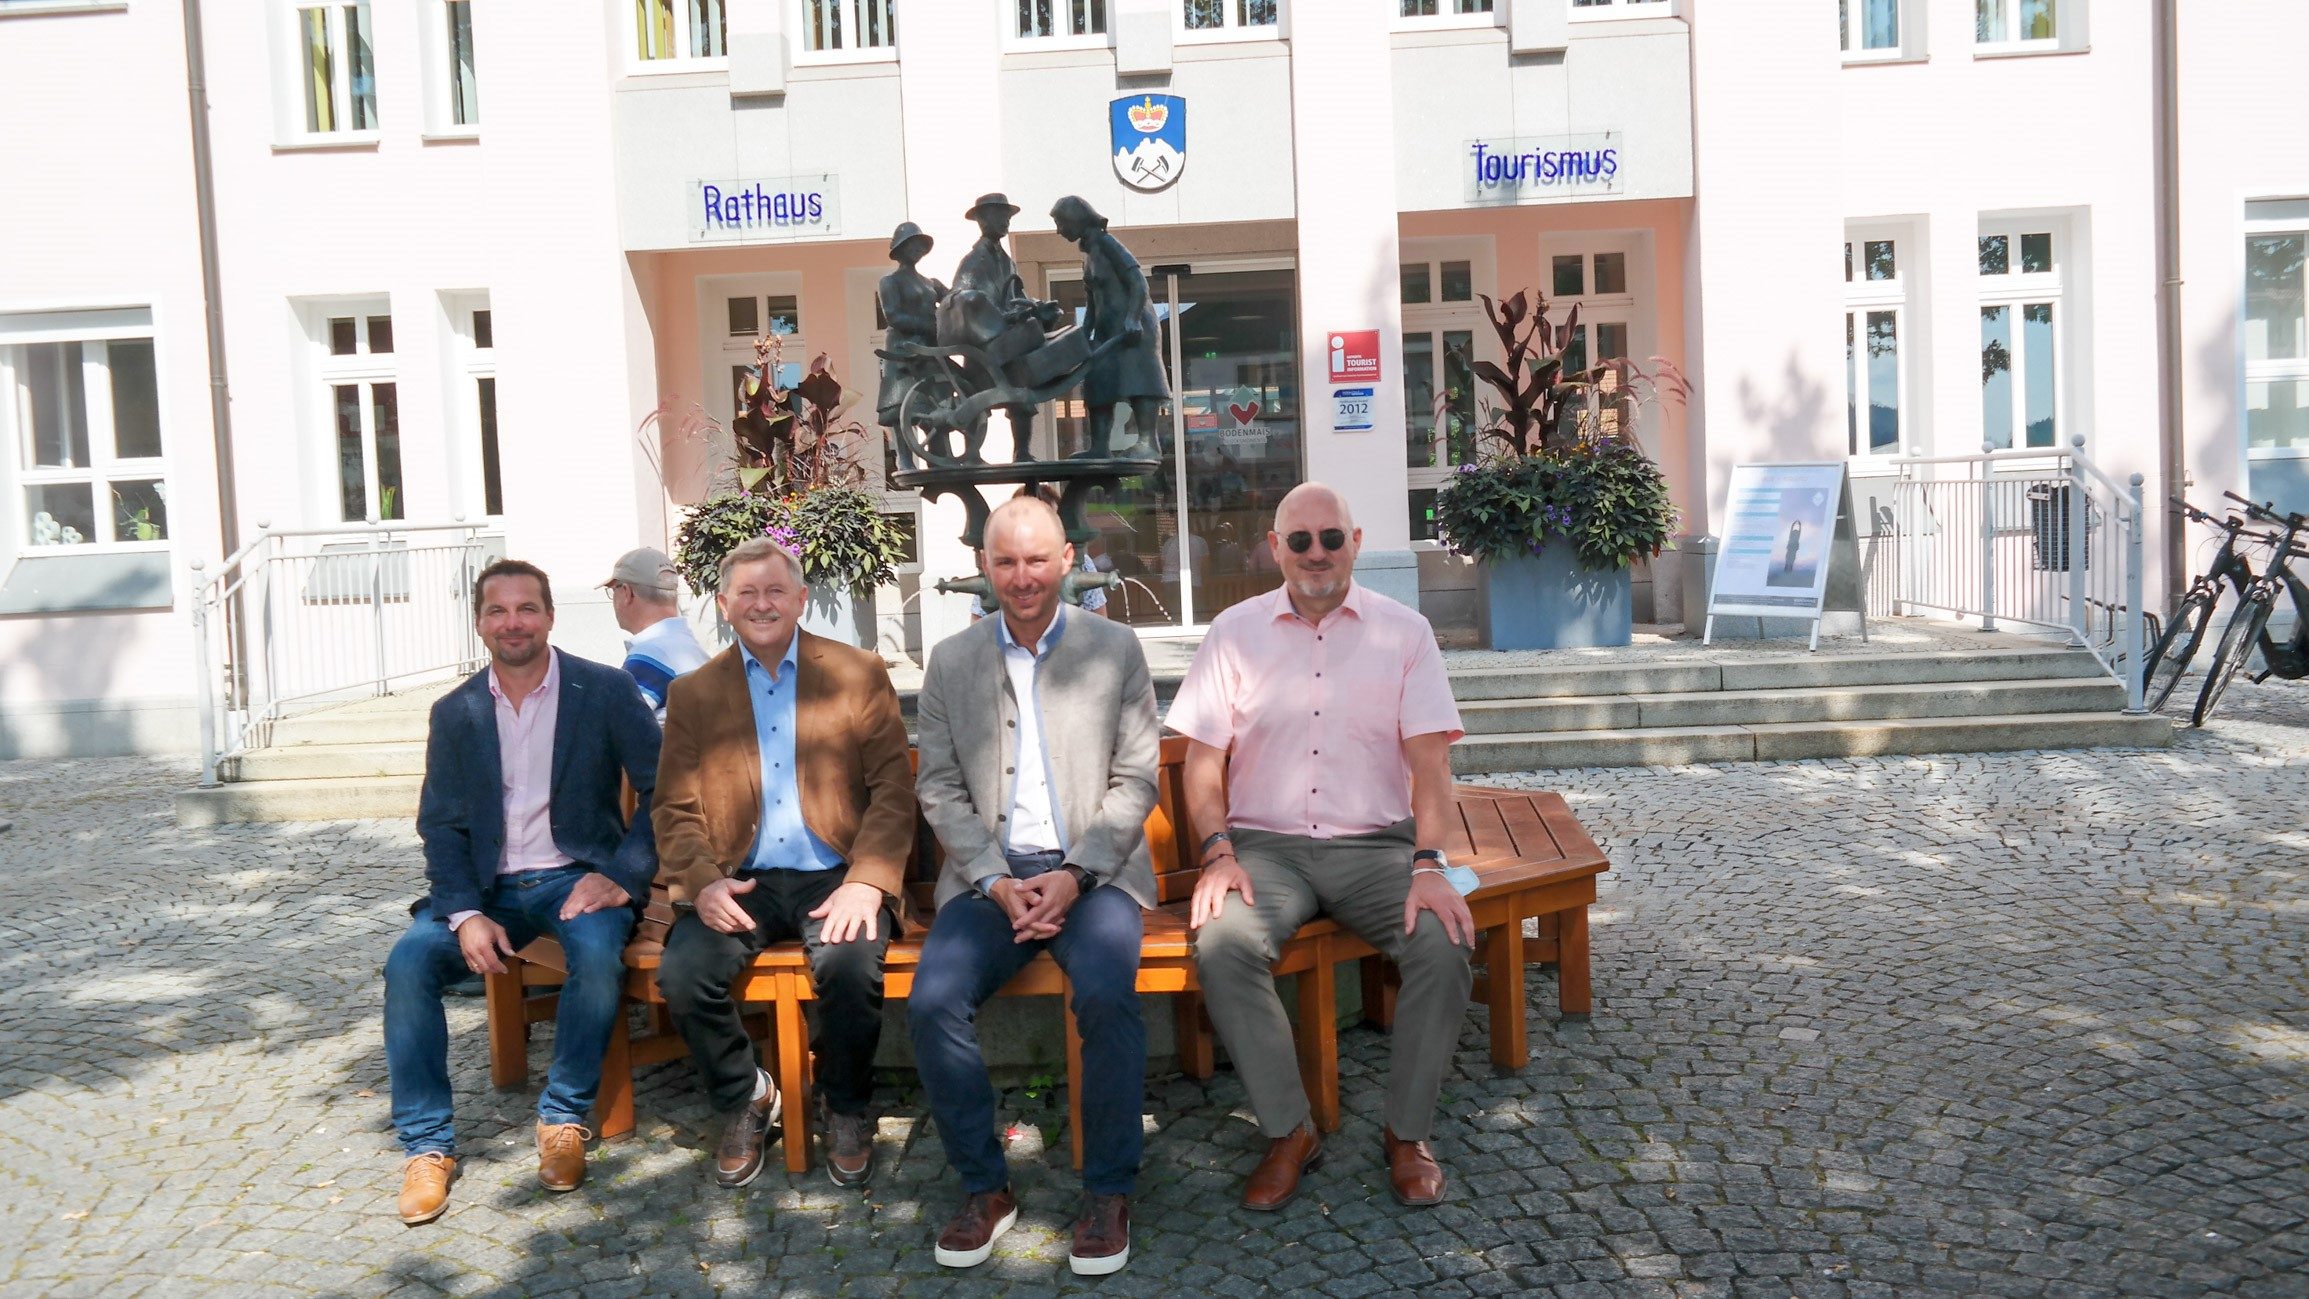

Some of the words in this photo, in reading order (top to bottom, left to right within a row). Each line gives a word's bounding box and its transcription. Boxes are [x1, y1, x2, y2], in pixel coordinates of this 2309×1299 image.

[1471, 143, 1617, 181] Tourismus
[703, 182, 823, 222] Rathaus
[1346, 358, 1377, 367] TOURIST
[1339, 403, 1368, 415] 2012
[1219, 427, 1271, 438] BODENMAIS
